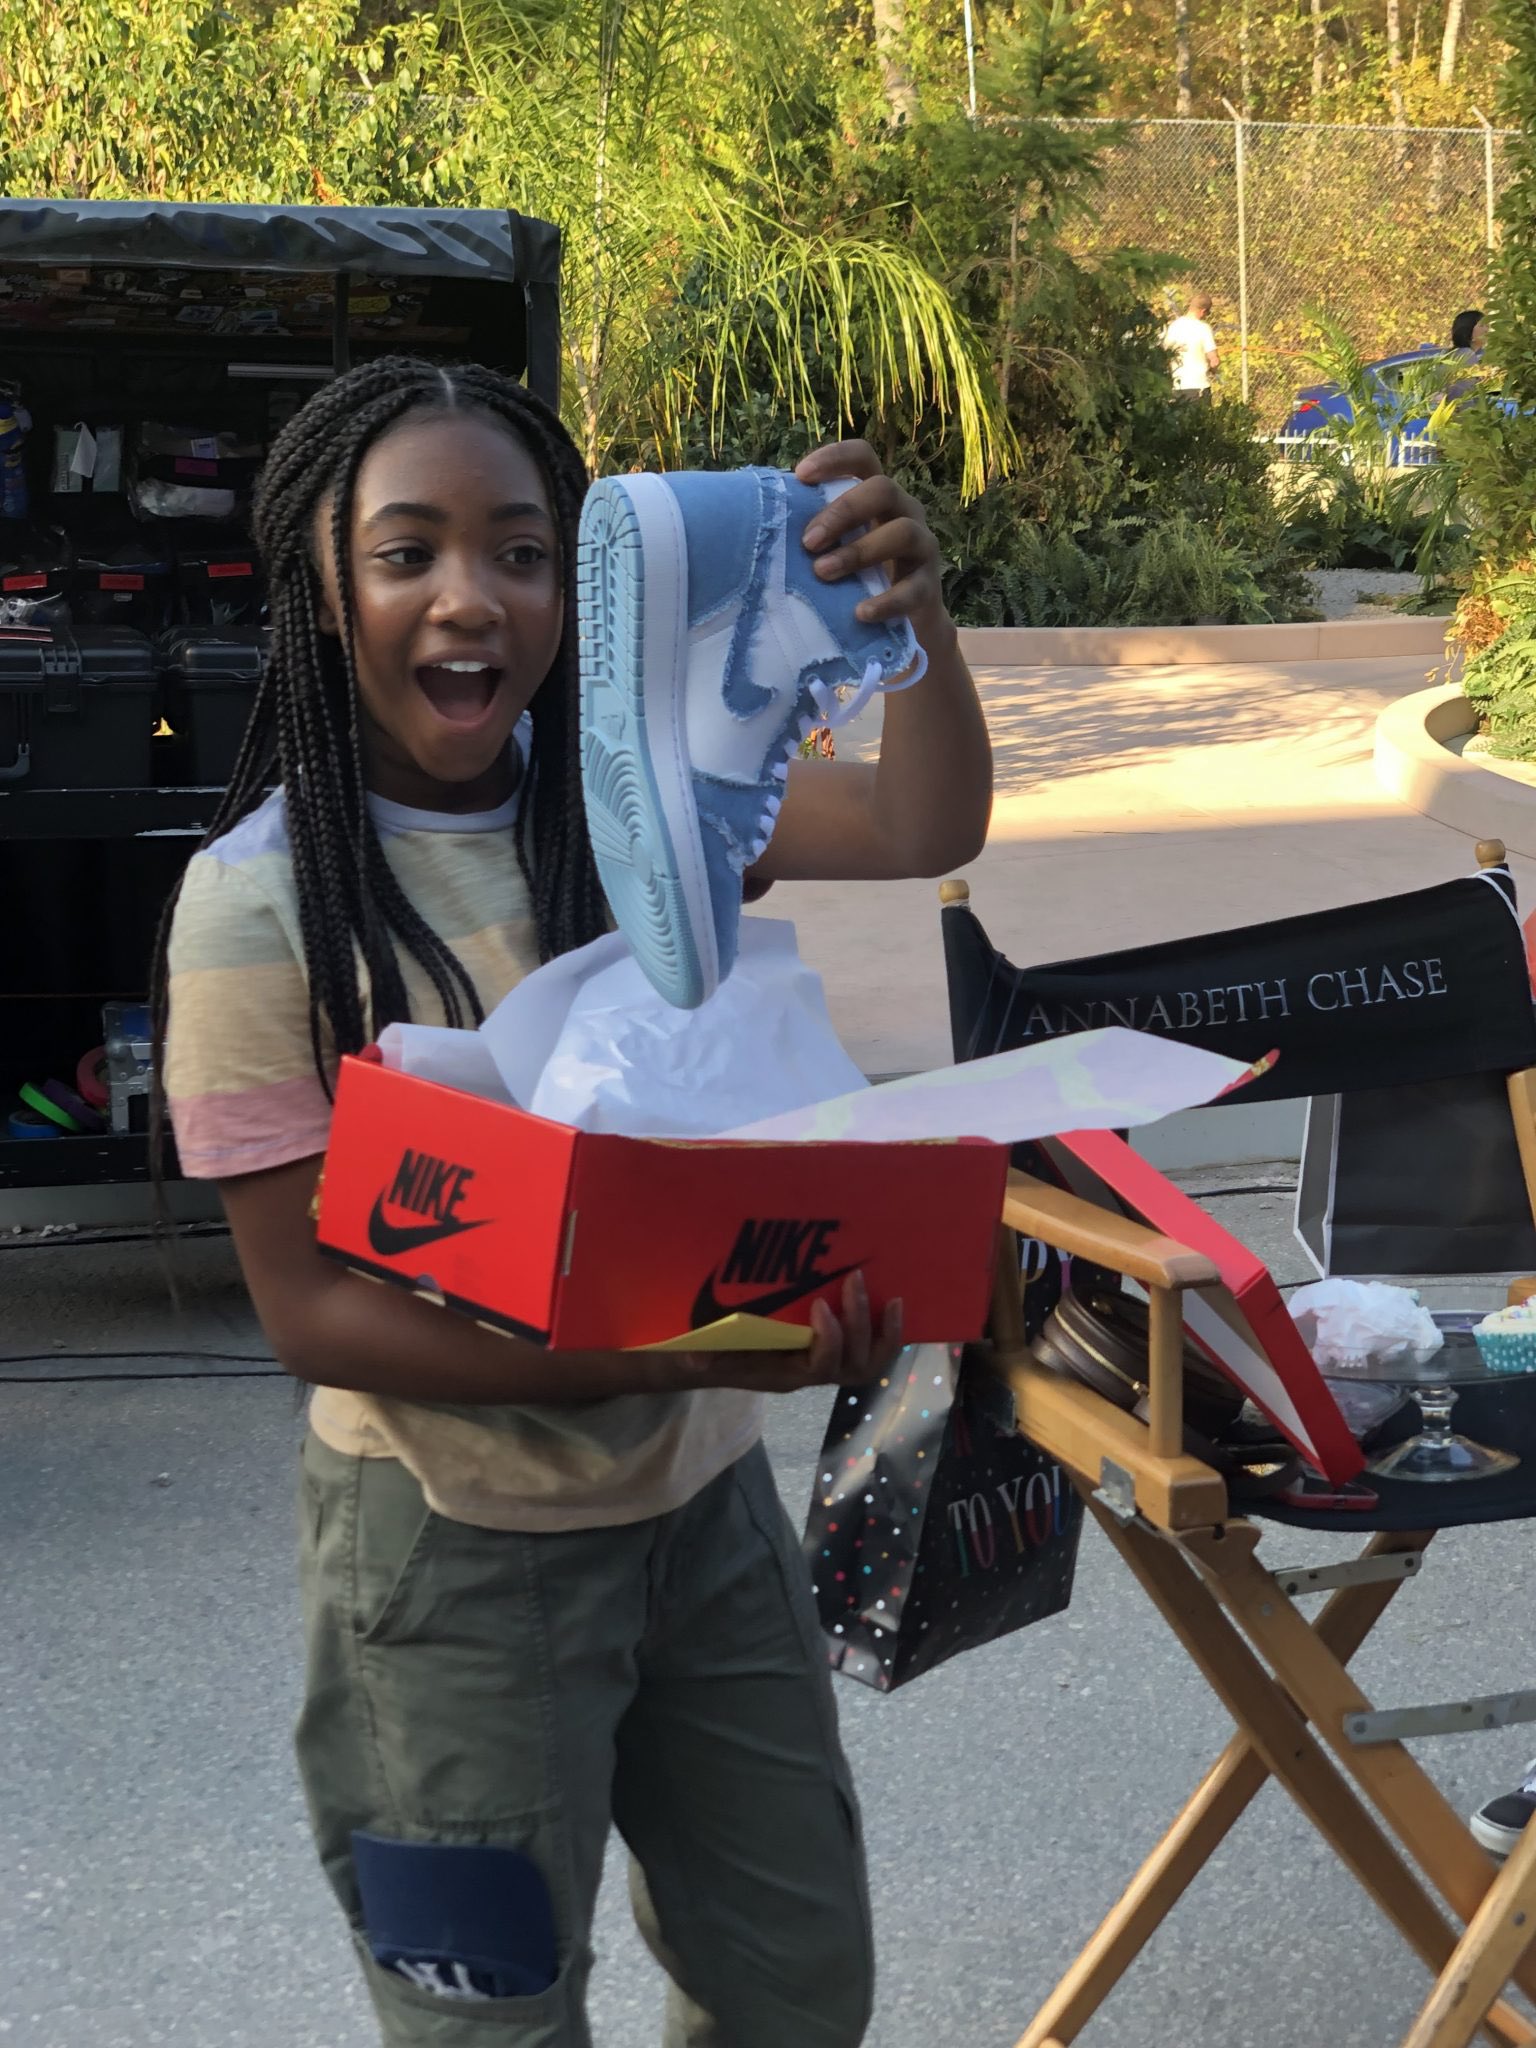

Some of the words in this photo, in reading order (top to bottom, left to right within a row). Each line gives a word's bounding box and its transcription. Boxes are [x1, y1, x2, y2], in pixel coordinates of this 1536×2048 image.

[1022, 978, 1292, 1037] ANNABETH
[1307, 957, 1448, 1011] CHASE
[387, 1148, 475, 1224] NIKE
[721, 1219, 840, 1285] NIKE
[947, 1492, 996, 1578] TO
[996, 1465, 1074, 1555] YOU
